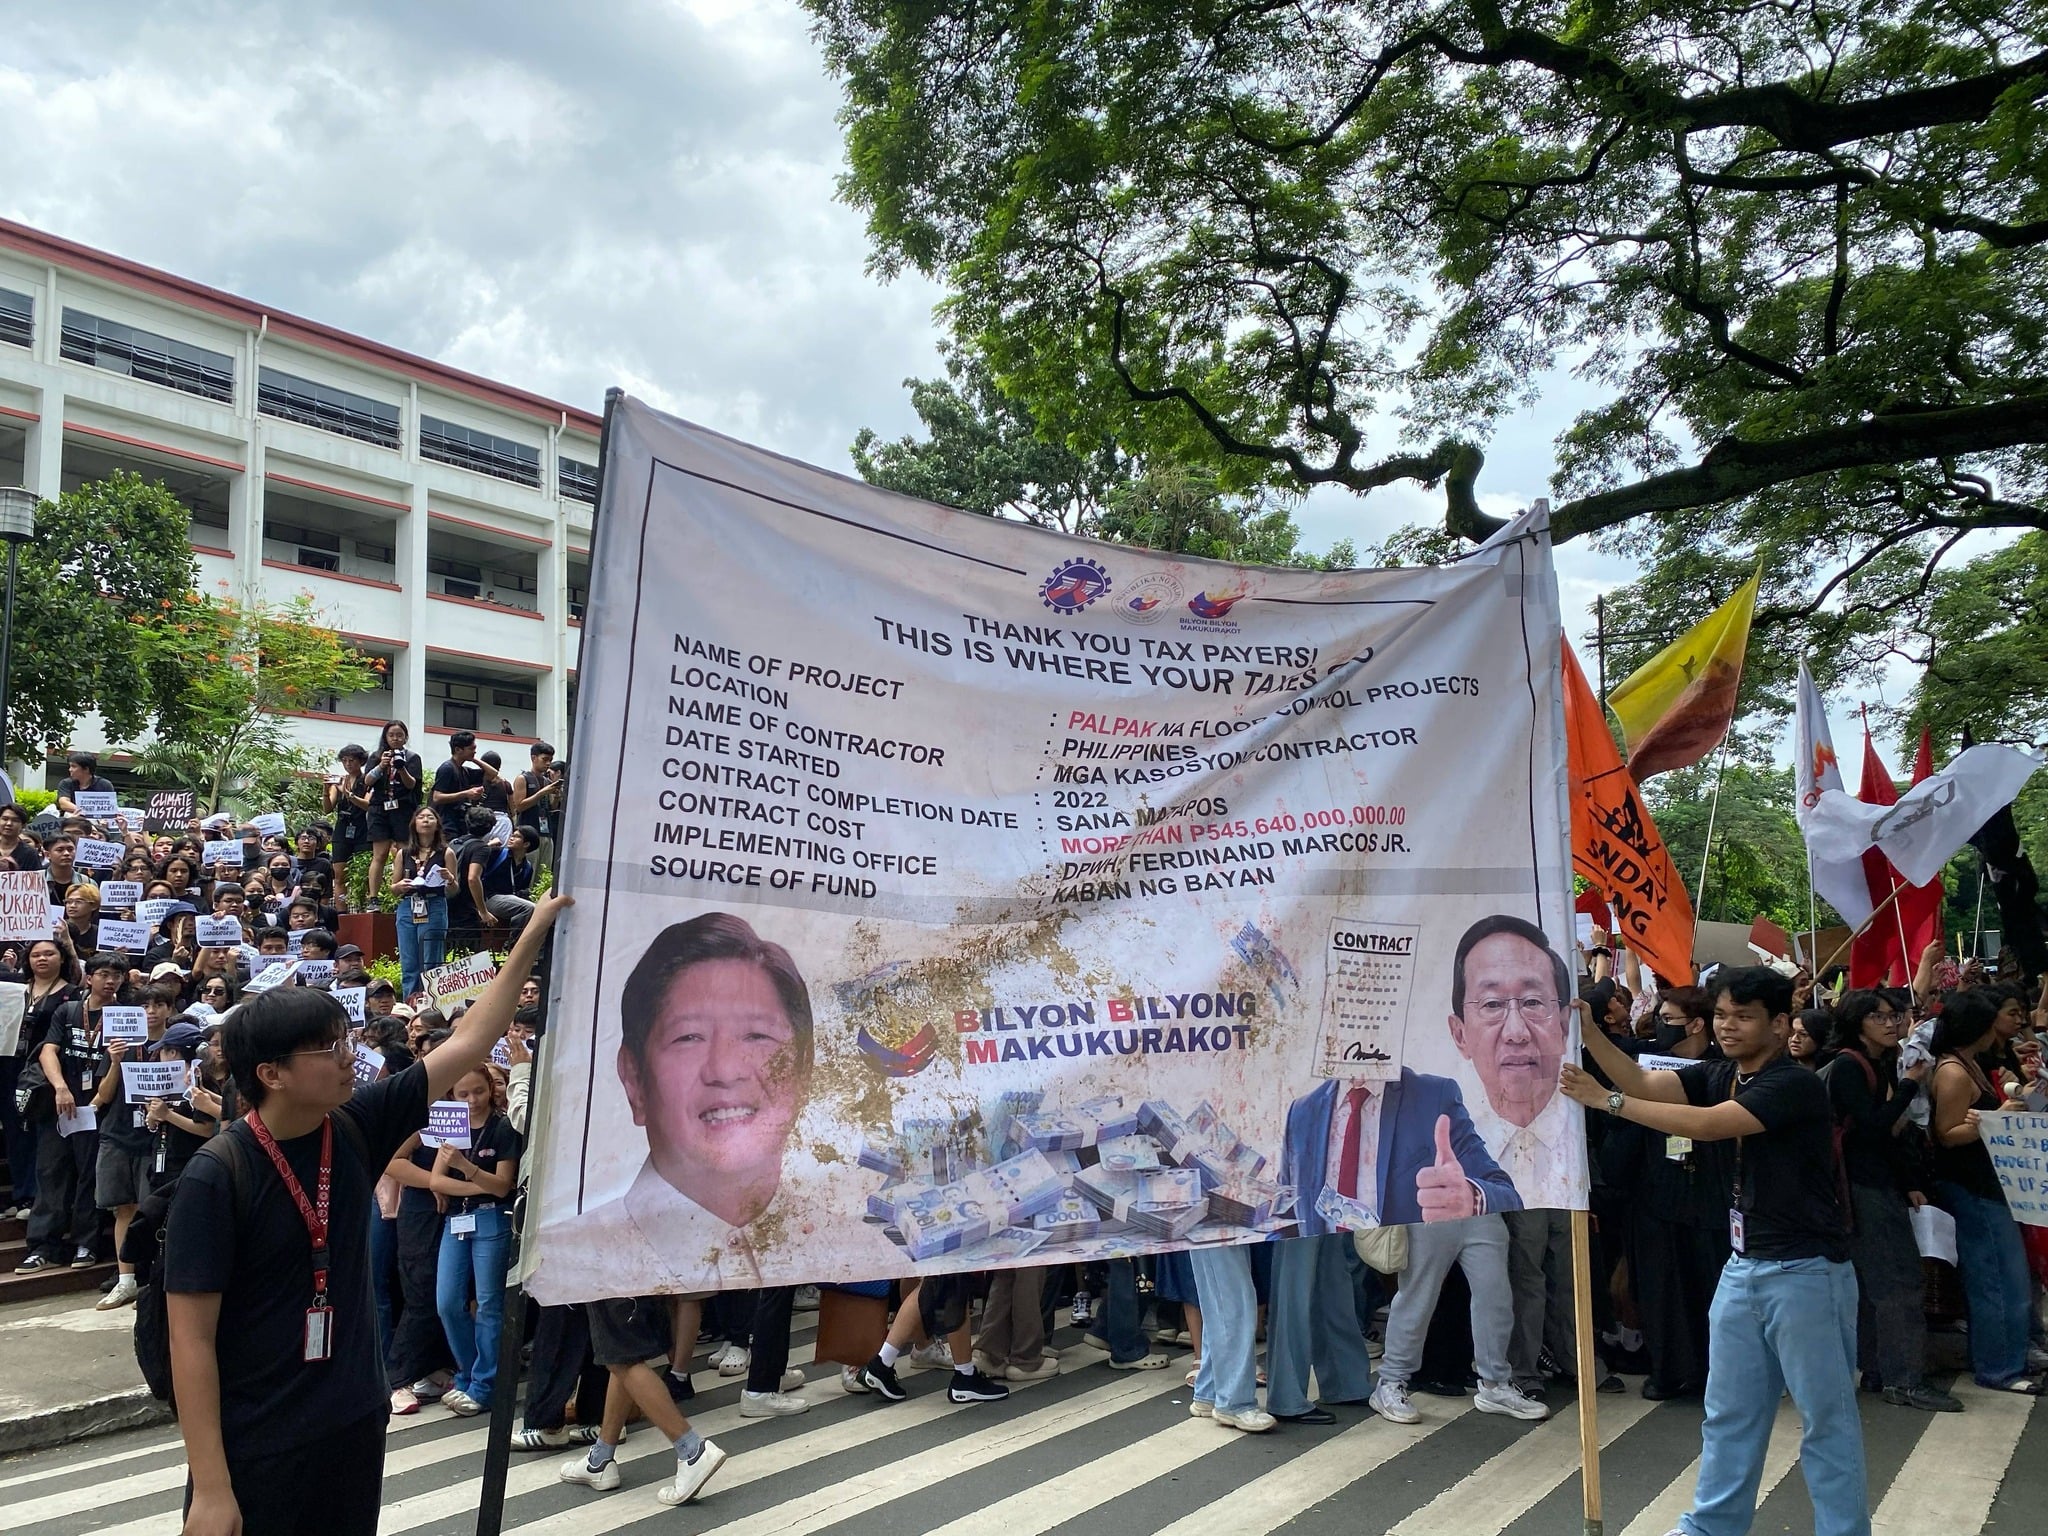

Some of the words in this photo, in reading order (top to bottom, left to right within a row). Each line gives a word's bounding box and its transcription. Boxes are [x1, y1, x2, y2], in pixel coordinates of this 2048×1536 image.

[963, 614, 1063, 648] THANK
[1072, 631, 1130, 656] YOU
[1139, 638, 1196, 661] TAX
[1203, 644, 1318, 668] PAYERS!
[1180, 617, 1207, 626] BILYON
[1180, 625, 1241, 634] MAKUKURAKOT
[673, 633, 741, 669] NAME
[748, 655, 782, 677] OF
[789, 662, 904, 700] PROJECT
[874, 616, 952, 656] THIS
[964, 638, 995, 664] IS
[1004, 646, 1131, 685] WHERE
[1140, 664, 1234, 695] YOUR
[1244, 666, 1316, 696] TAXES
[670, 664, 788, 709] LOCATION
[1068, 711, 1157, 738] PALPAK
[1157, 722, 1185, 737] NA
[1366, 676, 1479, 703] PROJECTS
[668, 695, 742, 726] NAME
[749, 712, 779, 733] OF
[785, 721, 945, 767] CONTRACTOR
[1062, 738, 1198, 762] PHILIPPINES
[665, 726, 730, 755] DATE
[738, 739, 840, 779] STARTED
[1053, 765, 1107, 784] MGA
[1255, 727, 1418, 762] CONTRACTOR
[145, 806, 192, 819] JUSTICE
[151, 792, 194, 807] CLIMATE
[662, 758, 801, 797] CONTRACT
[807, 783, 954, 822] COMPLETION
[961, 808, 1018, 829] DATE
[1053, 790, 1109, 808] 2022
[163, 820, 190, 830] NOW
[658, 790, 800, 827] CONTRACT
[807, 812, 865, 841] COST
[1056, 812, 1130, 831] SANA
[1136, 798, 1228, 827] MATAPOS
[1061, 835, 1132, 854] MORE
[1132, 825, 1183, 846] THAN
[1190, 806, 1405, 842] P545,640,000,000.00
[83, 843, 120, 854] PANAGUTIN
[654, 822, 846, 865] IMPLEMENTING
[852, 851, 937, 875] OFFICE
[1129, 842, 1275, 873] FERDINAND
[1282, 833, 1378, 857] MARCOS
[1381, 834, 1411, 853] JR.
[650, 855, 762, 886] SOURCE
[769, 868, 805, 890] OF
[811, 873, 877, 899] FUND
[1051, 881, 1132, 904] KABAN
[1139, 878, 1177, 897] NG
[1184, 867, 1275, 892] BAYAN
[0, 893, 46, 916] UKRATA
[1334, 932, 1412, 951] CONTRACT
[430, 969, 442, 978] UP
[447, 958, 472, 973] FIGHT
[953, 1001, 1095, 1033] BILYON
[1107, 991, 1256, 1023] BILYONG
[966, 1024, 1251, 1064] MAKUKURAKOT
[426, 1126, 467, 1134] PITALISMO!
